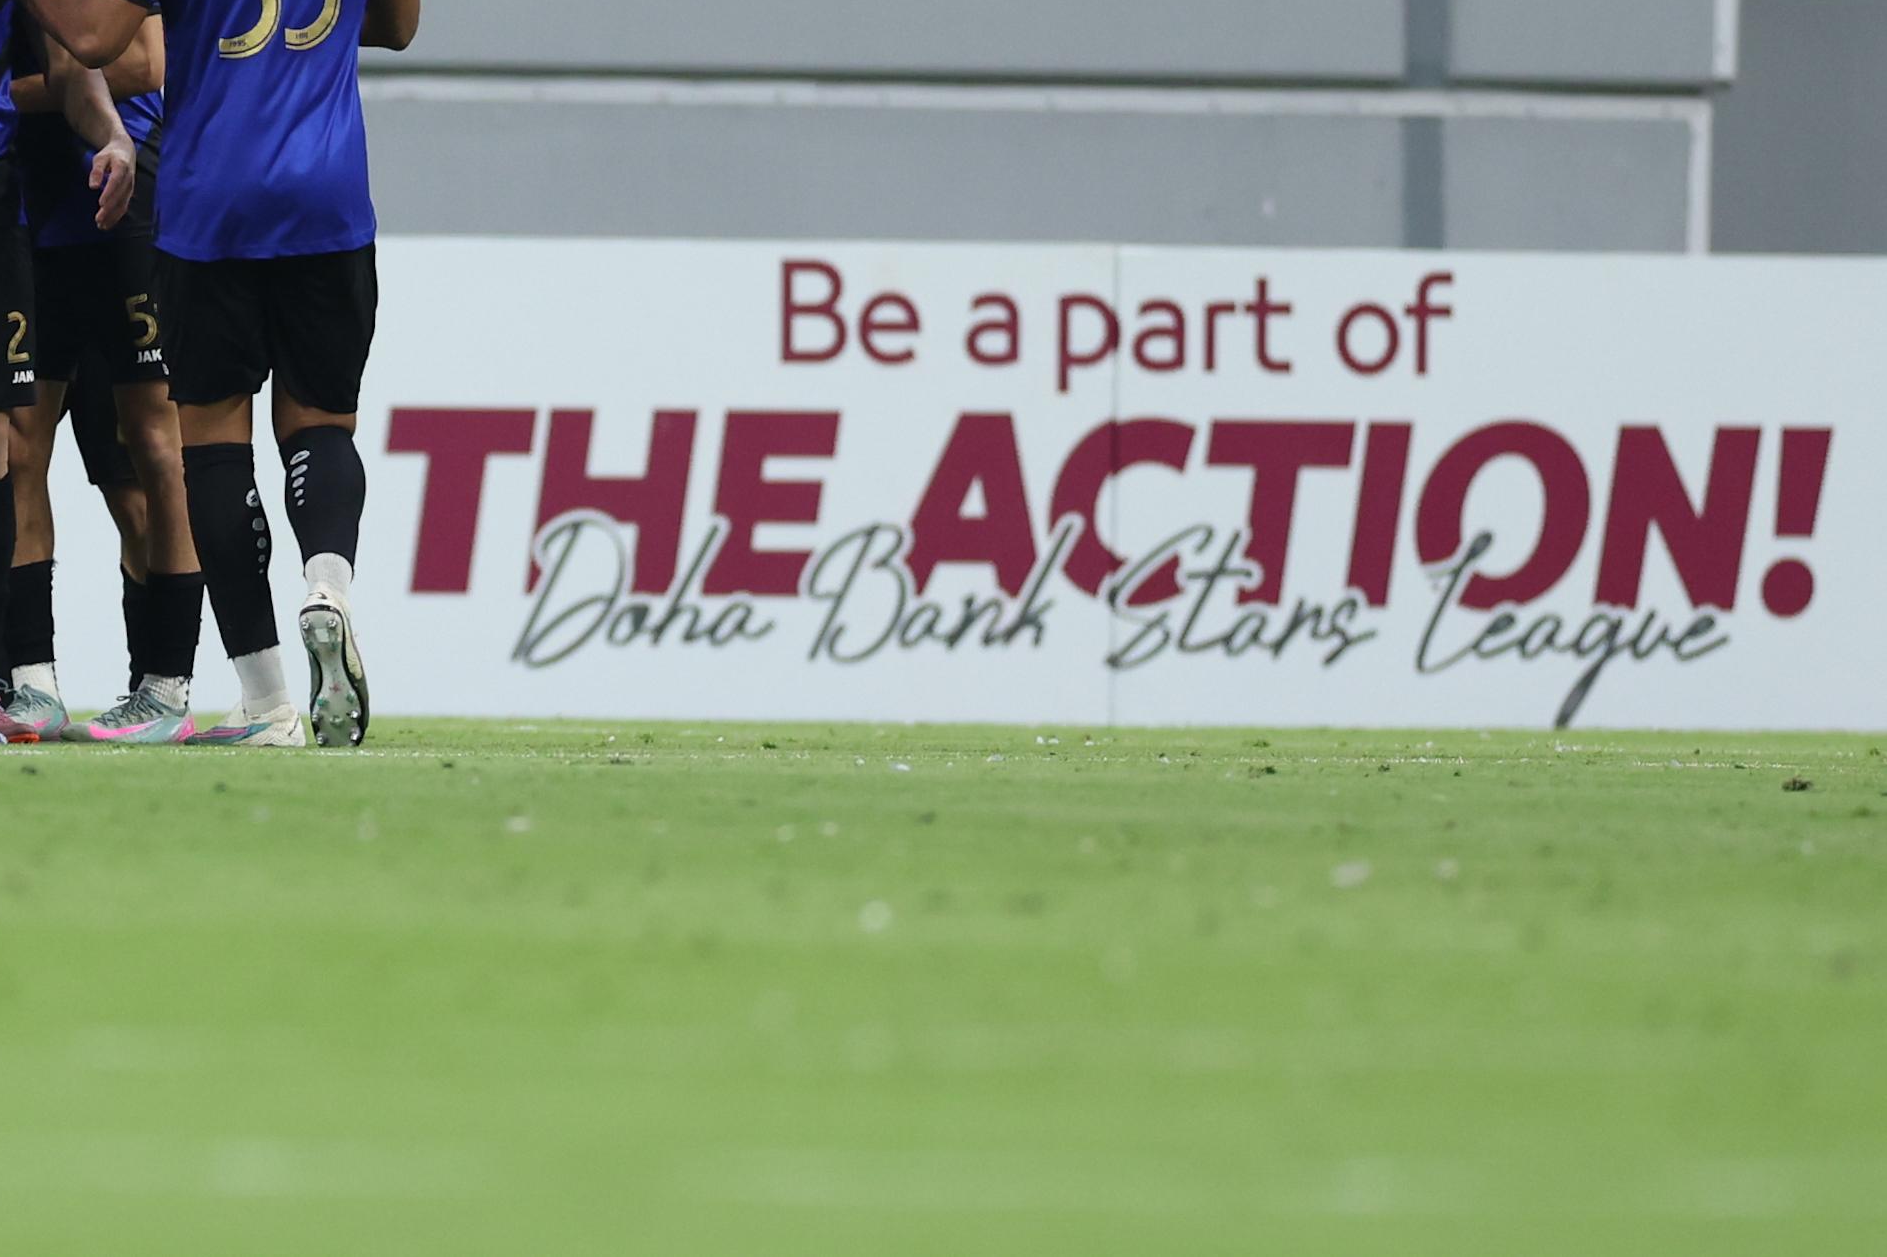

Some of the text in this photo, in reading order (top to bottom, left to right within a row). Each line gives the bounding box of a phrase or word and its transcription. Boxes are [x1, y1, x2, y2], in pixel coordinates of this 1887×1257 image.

[136, 348, 163, 364] JAK
[779, 259, 1454, 395] Be a part of
[385, 407, 1834, 619] THE ACTION!
[511, 518, 1730, 731] Doha Bank Stars League
